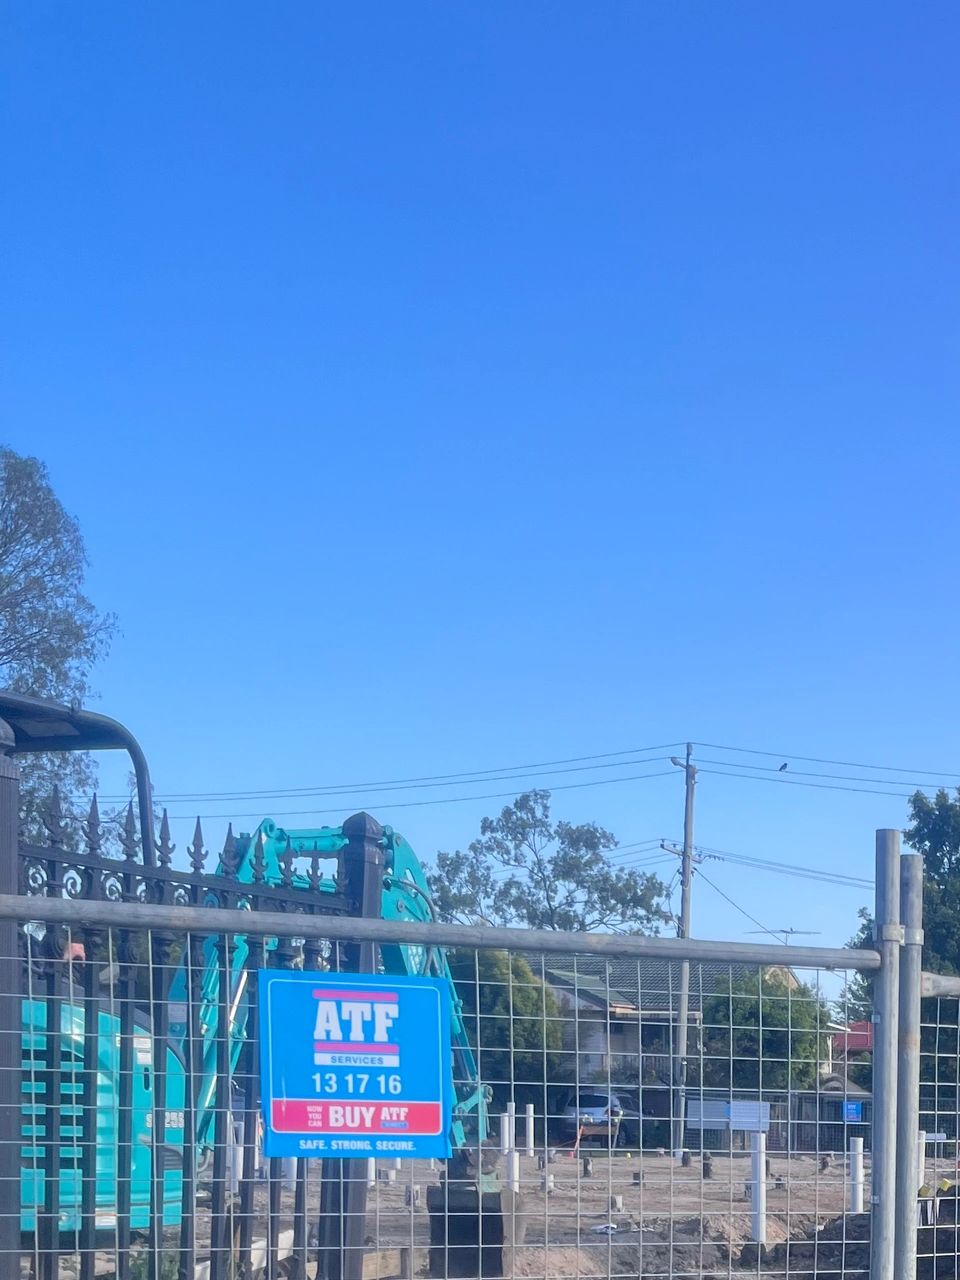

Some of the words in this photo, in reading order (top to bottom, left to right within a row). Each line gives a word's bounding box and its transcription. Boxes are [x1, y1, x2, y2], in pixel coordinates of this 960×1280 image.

[313, 1001, 399, 1042] ATF
[330, 1055, 384, 1066] SERVICES
[312, 1073, 338, 1093] 13
[344, 1074, 370, 1094] 17
[377, 1075, 402, 1095] 16
[306, 1105, 323, 1113] NOW
[329, 1105, 376, 1128] BUY
[381, 1107, 409, 1121] ATF
[299, 1139, 328, 1150] SAFE.
[331, 1140, 373, 1150] STRONG.
[375, 1141, 417, 1151] SECURE.
